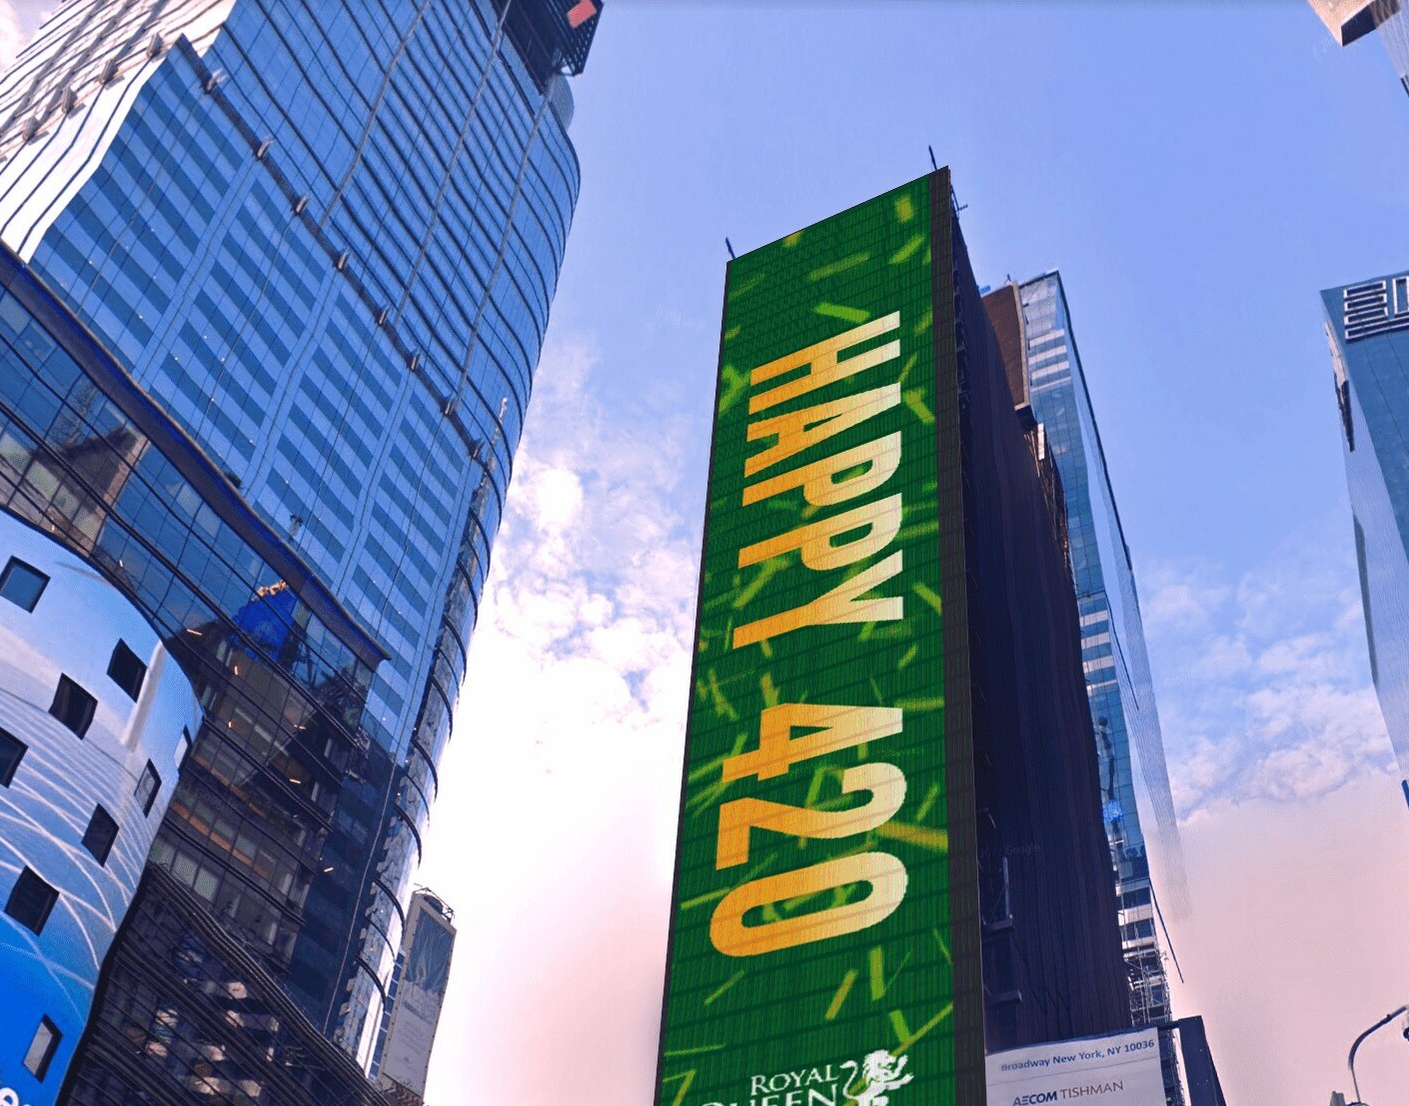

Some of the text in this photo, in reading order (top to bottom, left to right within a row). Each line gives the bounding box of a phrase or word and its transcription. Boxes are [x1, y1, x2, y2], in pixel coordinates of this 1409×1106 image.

[710, 311, 908, 957] HAPPY 420
[1000, 1039, 1155, 1073] Broadway New York, NY 10036
[749, 1063, 841, 1096] ROYAL
[1060, 1080, 1124, 1100] TISHMAN
